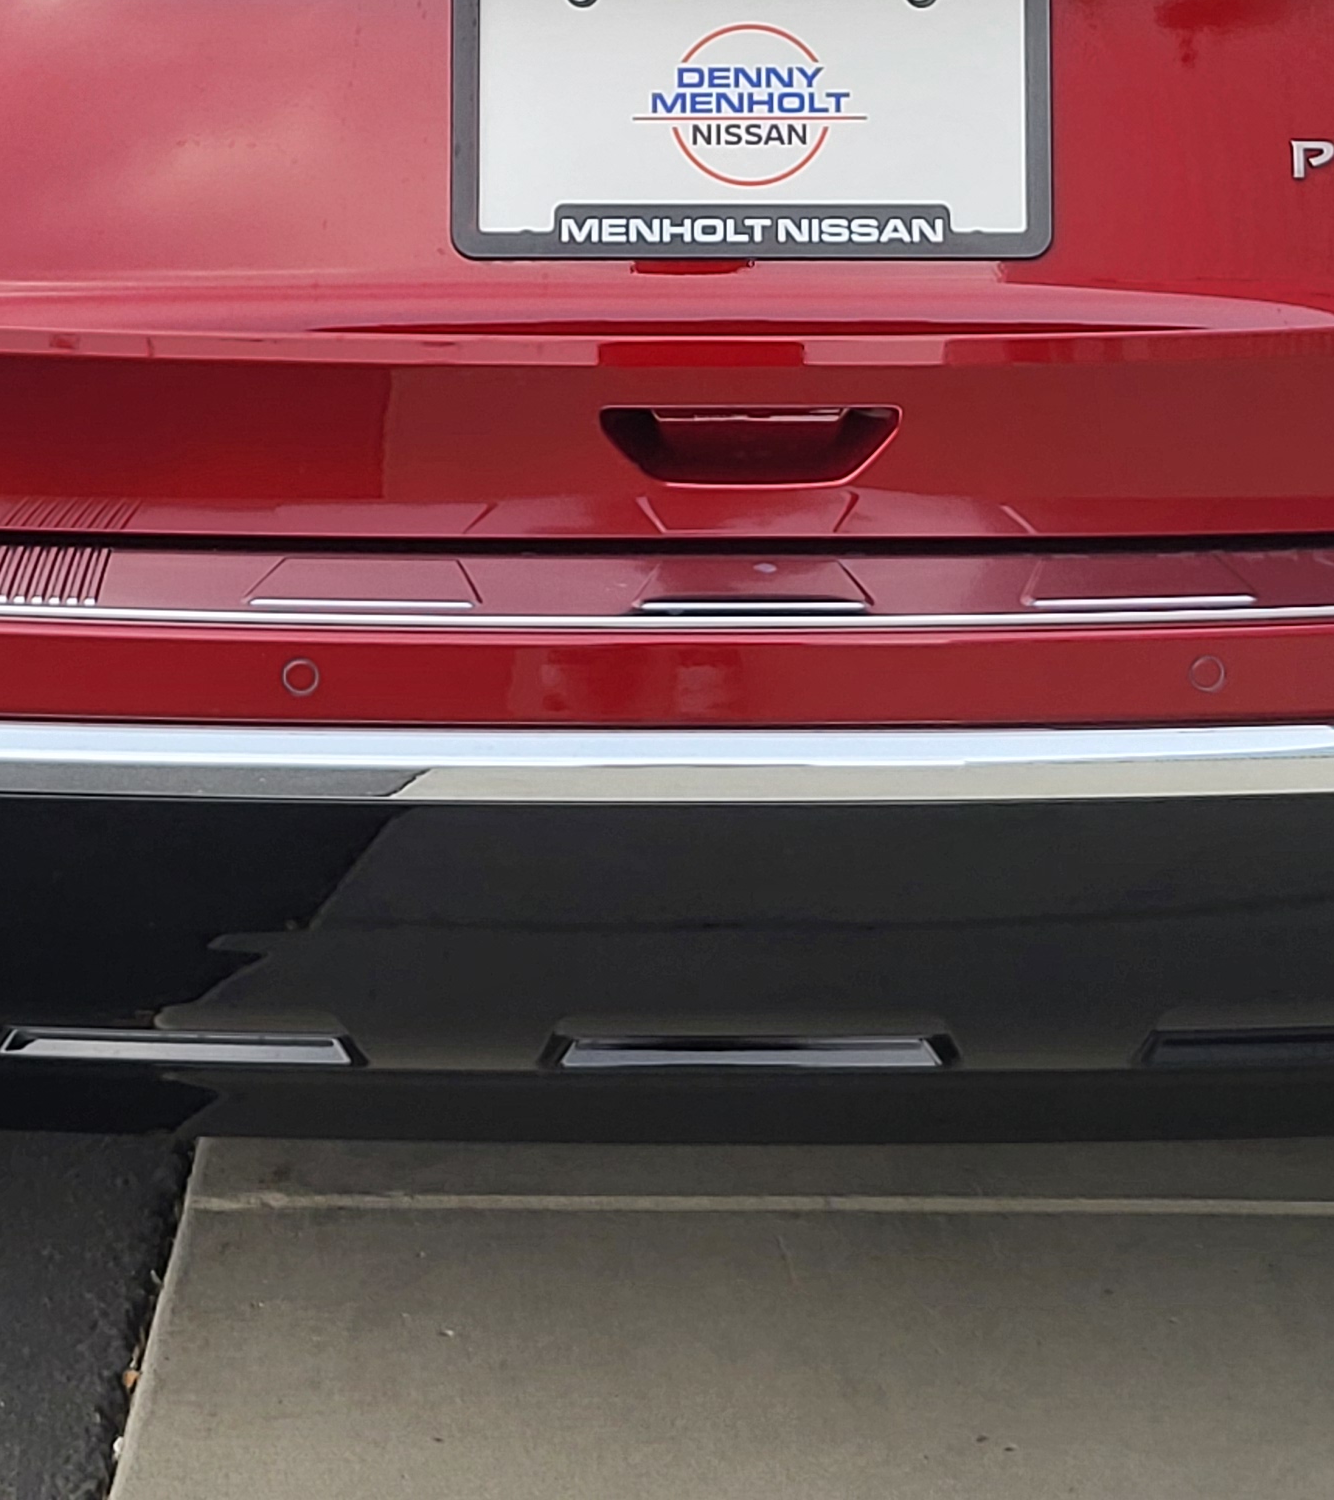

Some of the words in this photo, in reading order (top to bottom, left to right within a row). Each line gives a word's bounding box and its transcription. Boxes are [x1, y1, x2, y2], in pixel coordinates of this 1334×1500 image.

[677, 66, 824, 88] DENNY
[651, 92, 850, 114] MENHOLT
[692, 124, 808, 146] NISSAN
[560, 218, 772, 243] MENHOLT
[777, 218, 945, 243] NISSAN
